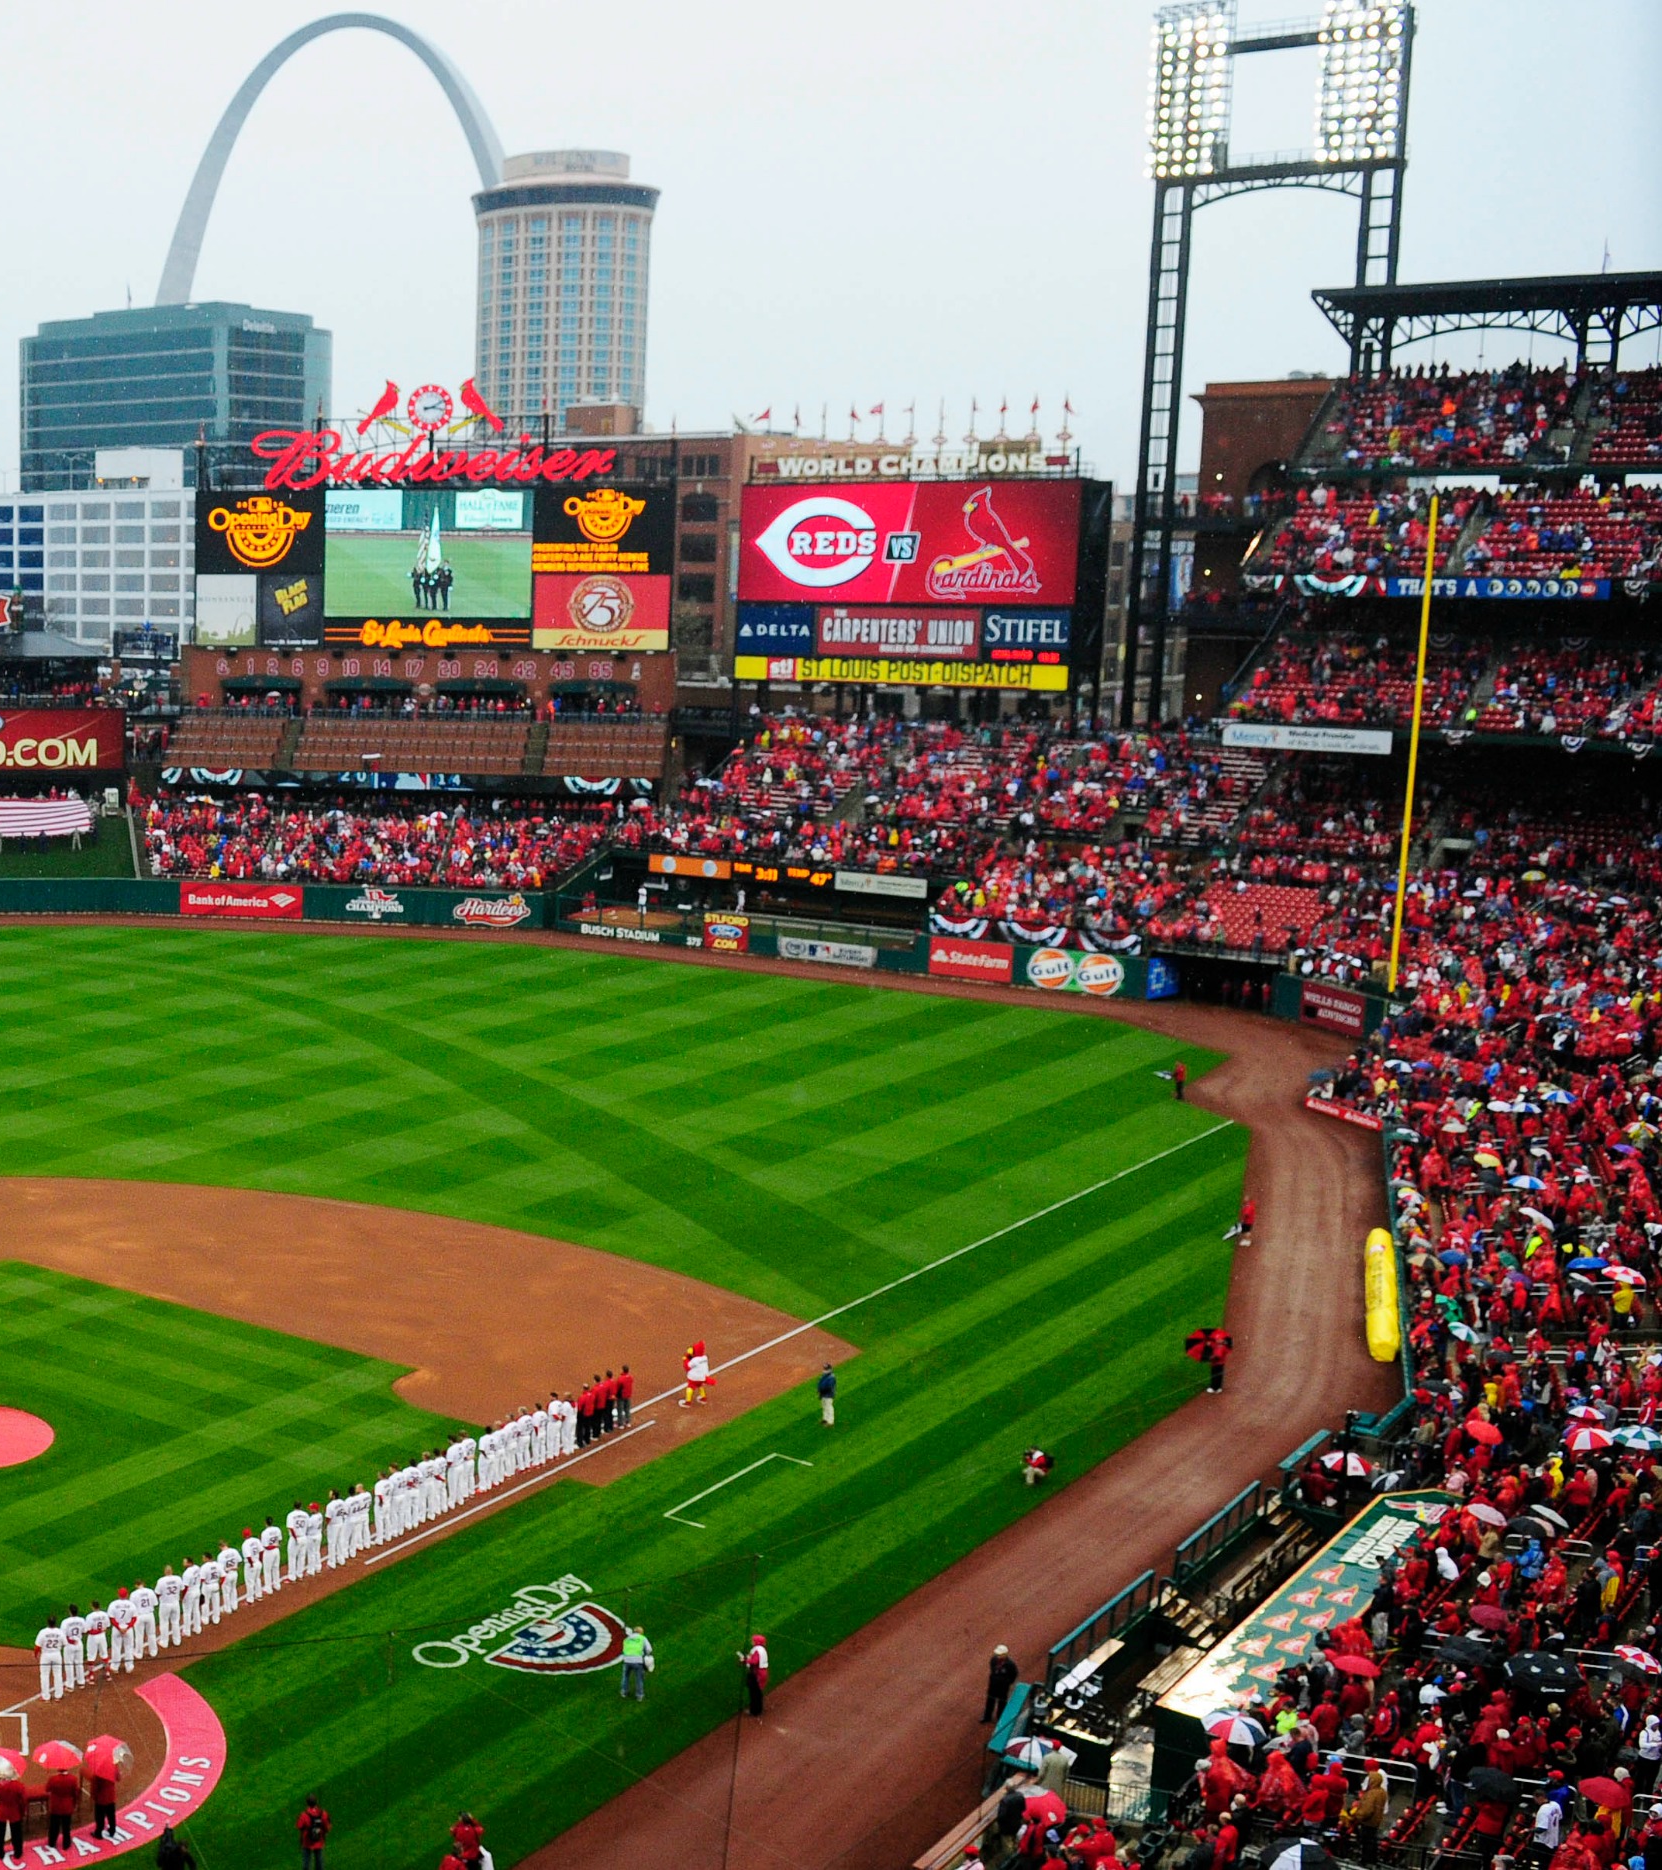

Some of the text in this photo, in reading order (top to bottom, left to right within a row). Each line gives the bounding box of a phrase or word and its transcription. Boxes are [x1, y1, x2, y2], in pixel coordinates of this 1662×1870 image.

[251, 430, 617, 489] Budweiser
[777, 453, 1047, 477] WORLD CHAMPIONS
[208, 506, 312, 531] Opening Day
[789, 530, 878, 556] REDS
[890, 537, 913, 559] VS
[925, 555, 1042, 600] Cardinals
[1465, 579, 1478, 596] A
[274, 577, 308, 605] BLACK
[282, 592, 308, 617] FLAG
[756, 622, 811, 637] DELTA
[822, 616, 975, 646] CARPENTERS' UNION
[985, 613, 1069, 644] STIFEL
[555, 634, 645, 647] Schnucks
[266, 657, 279, 676] 2
[291, 658, 304, 677] 6
[316, 658, 329, 677] 9
[342, 659, 360, 677] 10
[373, 659, 391, 677] 14
[405, 659, 424, 678] 17
[438, 660, 461, 678] 20
[474, 660, 498, 678] 24
[512, 660, 537, 679] 42
[550, 661, 575, 679] 45
[589, 661, 613, 679] 85
[802, 660, 1031, 685] ST. LOUIS POST-DISPATCH
[755, 866, 778, 882] 3:11
[188, 893, 269, 908] Bank of America
[346, 902, 404, 913] CHAMPIONS
[704, 912, 749, 927] STLFORD
[581, 923, 660, 943] BUSCH STADIUM
[1031, 960, 1071, 976] Gulf
[1078, 967, 1118, 982] Gulf
[166, 1586, 177, 1595] 32
[141, 1598, 151, 1608] 21
[120, 1609, 126, 1619] 7
[411, 1572, 594, 1668] Opening Day
[97, 1621, 103, 1631] 8
[45, 1639, 59, 1649] 22
[1, 1755, 212, 1870] CHAMPIONS
